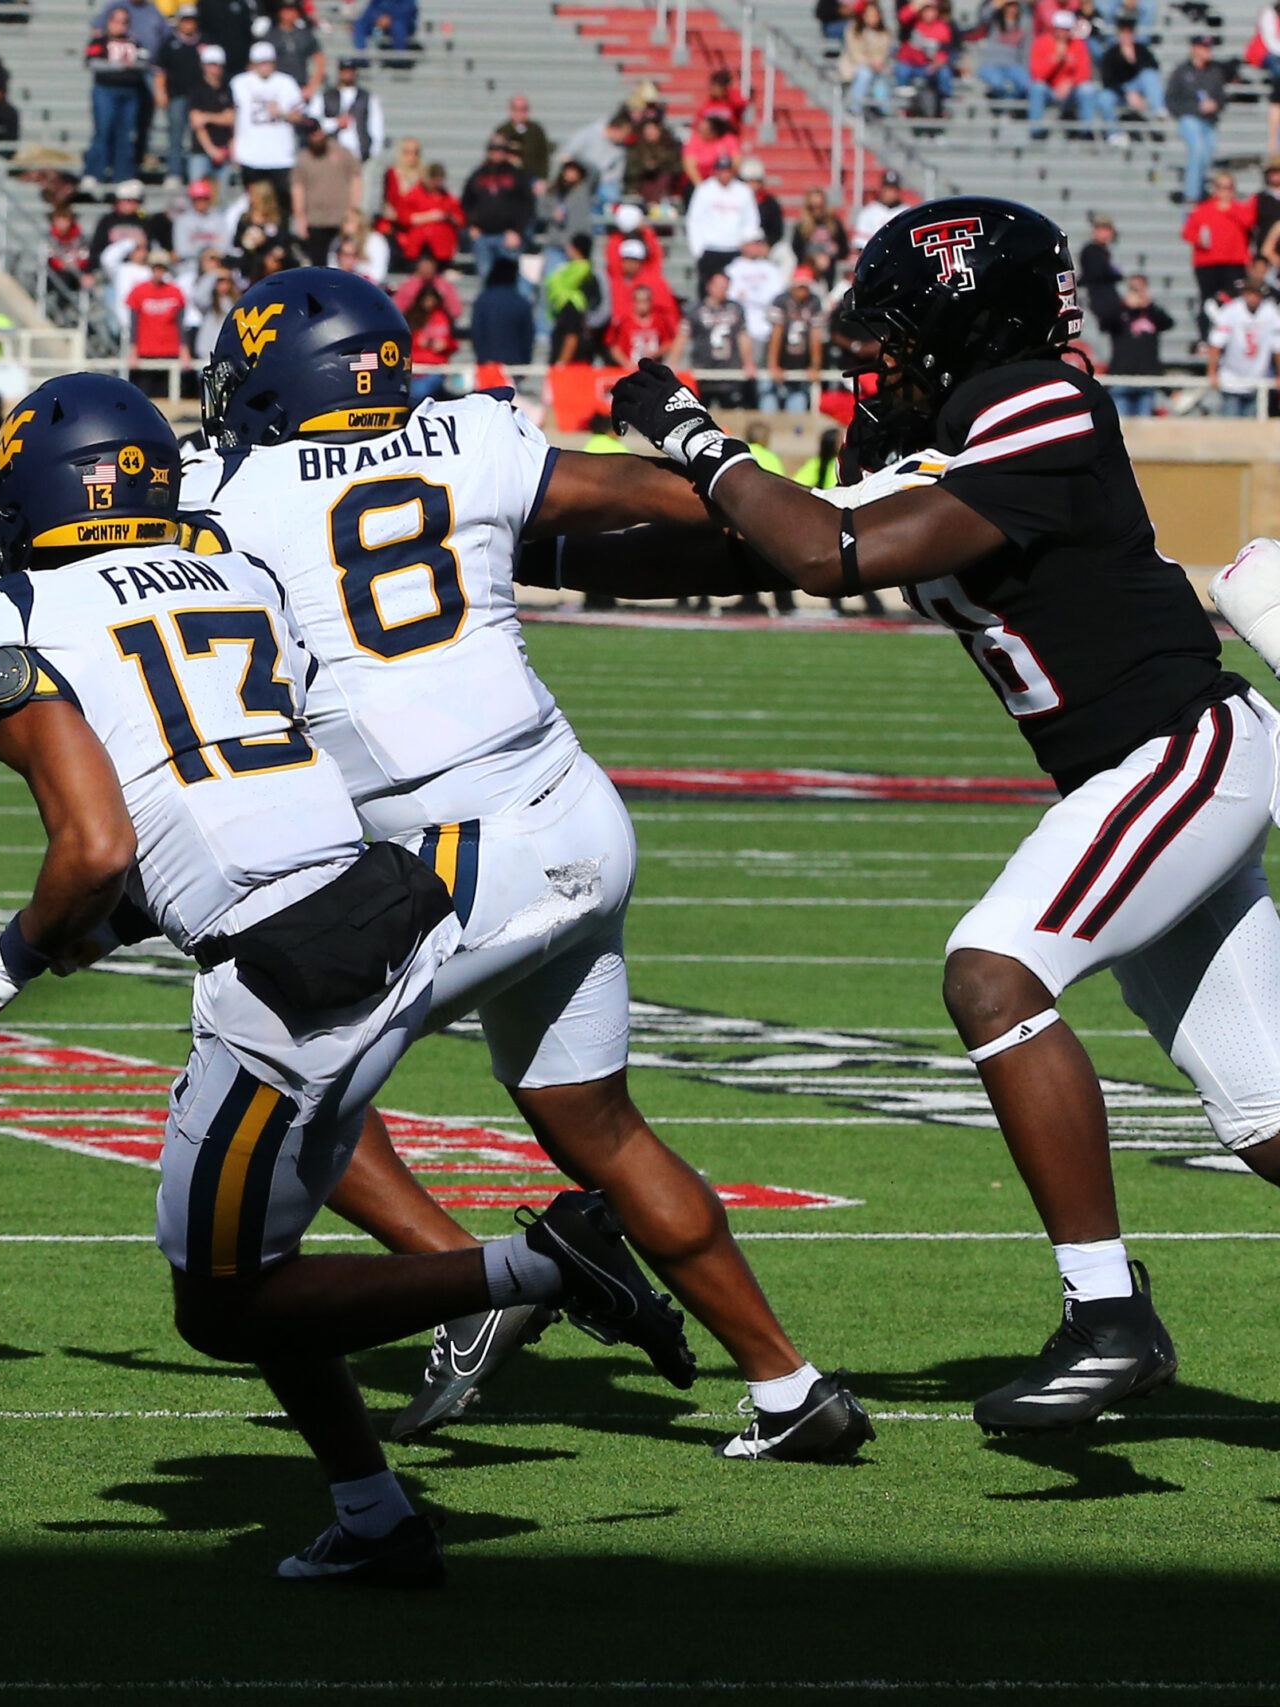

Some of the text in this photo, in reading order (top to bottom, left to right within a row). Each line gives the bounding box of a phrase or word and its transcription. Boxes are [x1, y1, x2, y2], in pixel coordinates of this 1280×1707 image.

[384, 351, 397, 362] 44
[356, 371, 372, 394] 8
[298, 415, 461, 481] BRADLEY
[122, 457, 140, 469] 44
[150, 467, 170, 485] XII
[86, 484, 113, 511] 13
[326, 473, 470, 663] 8
[98, 559, 230, 605] FAGAN
[106, 606, 319, 788] 13
